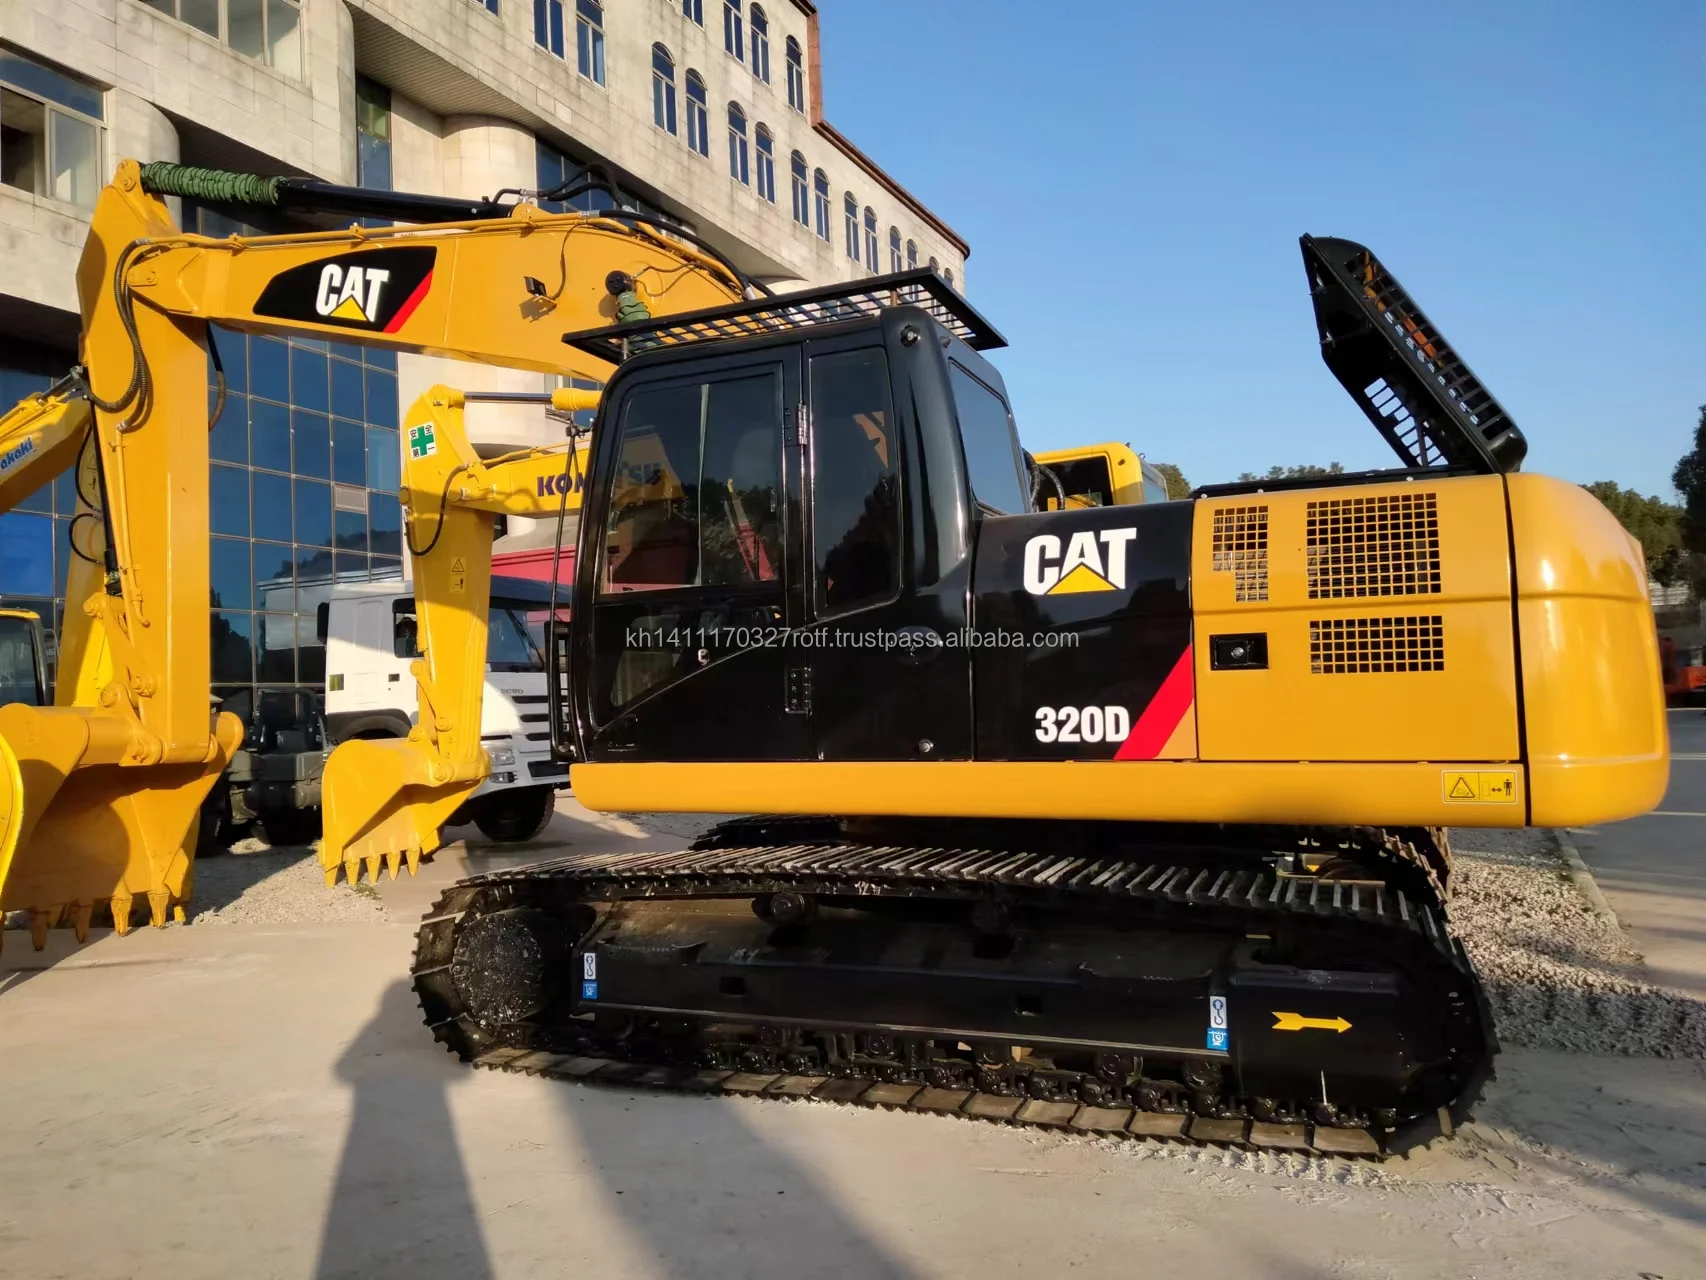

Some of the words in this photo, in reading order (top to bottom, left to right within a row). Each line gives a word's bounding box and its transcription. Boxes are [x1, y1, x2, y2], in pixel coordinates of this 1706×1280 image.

[316, 264, 389, 323] CAT
[1024, 527, 1137, 596] CAT
[1035, 706, 1130, 743] 320D
